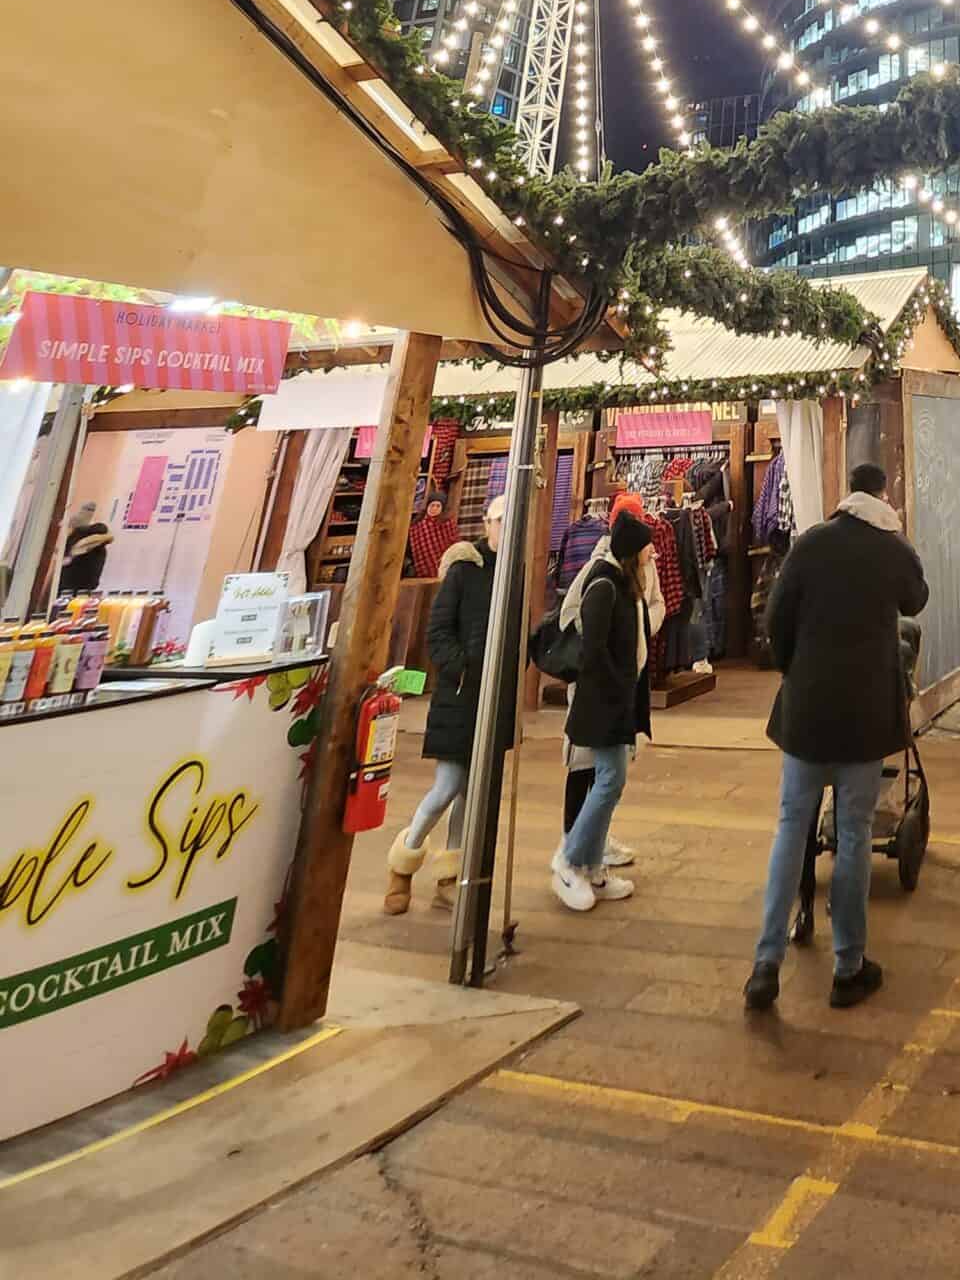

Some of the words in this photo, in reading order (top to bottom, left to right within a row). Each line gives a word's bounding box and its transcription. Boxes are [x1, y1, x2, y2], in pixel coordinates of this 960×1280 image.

[39, 338, 111, 363] SIMPLE
[113, 345, 153, 366] SIPS
[156, 349, 232, 375] COCKTAIL
[236, 356, 265, 376] MIX
[127, 760, 259, 900] Sips
[165, 912, 228, 958] MIX
